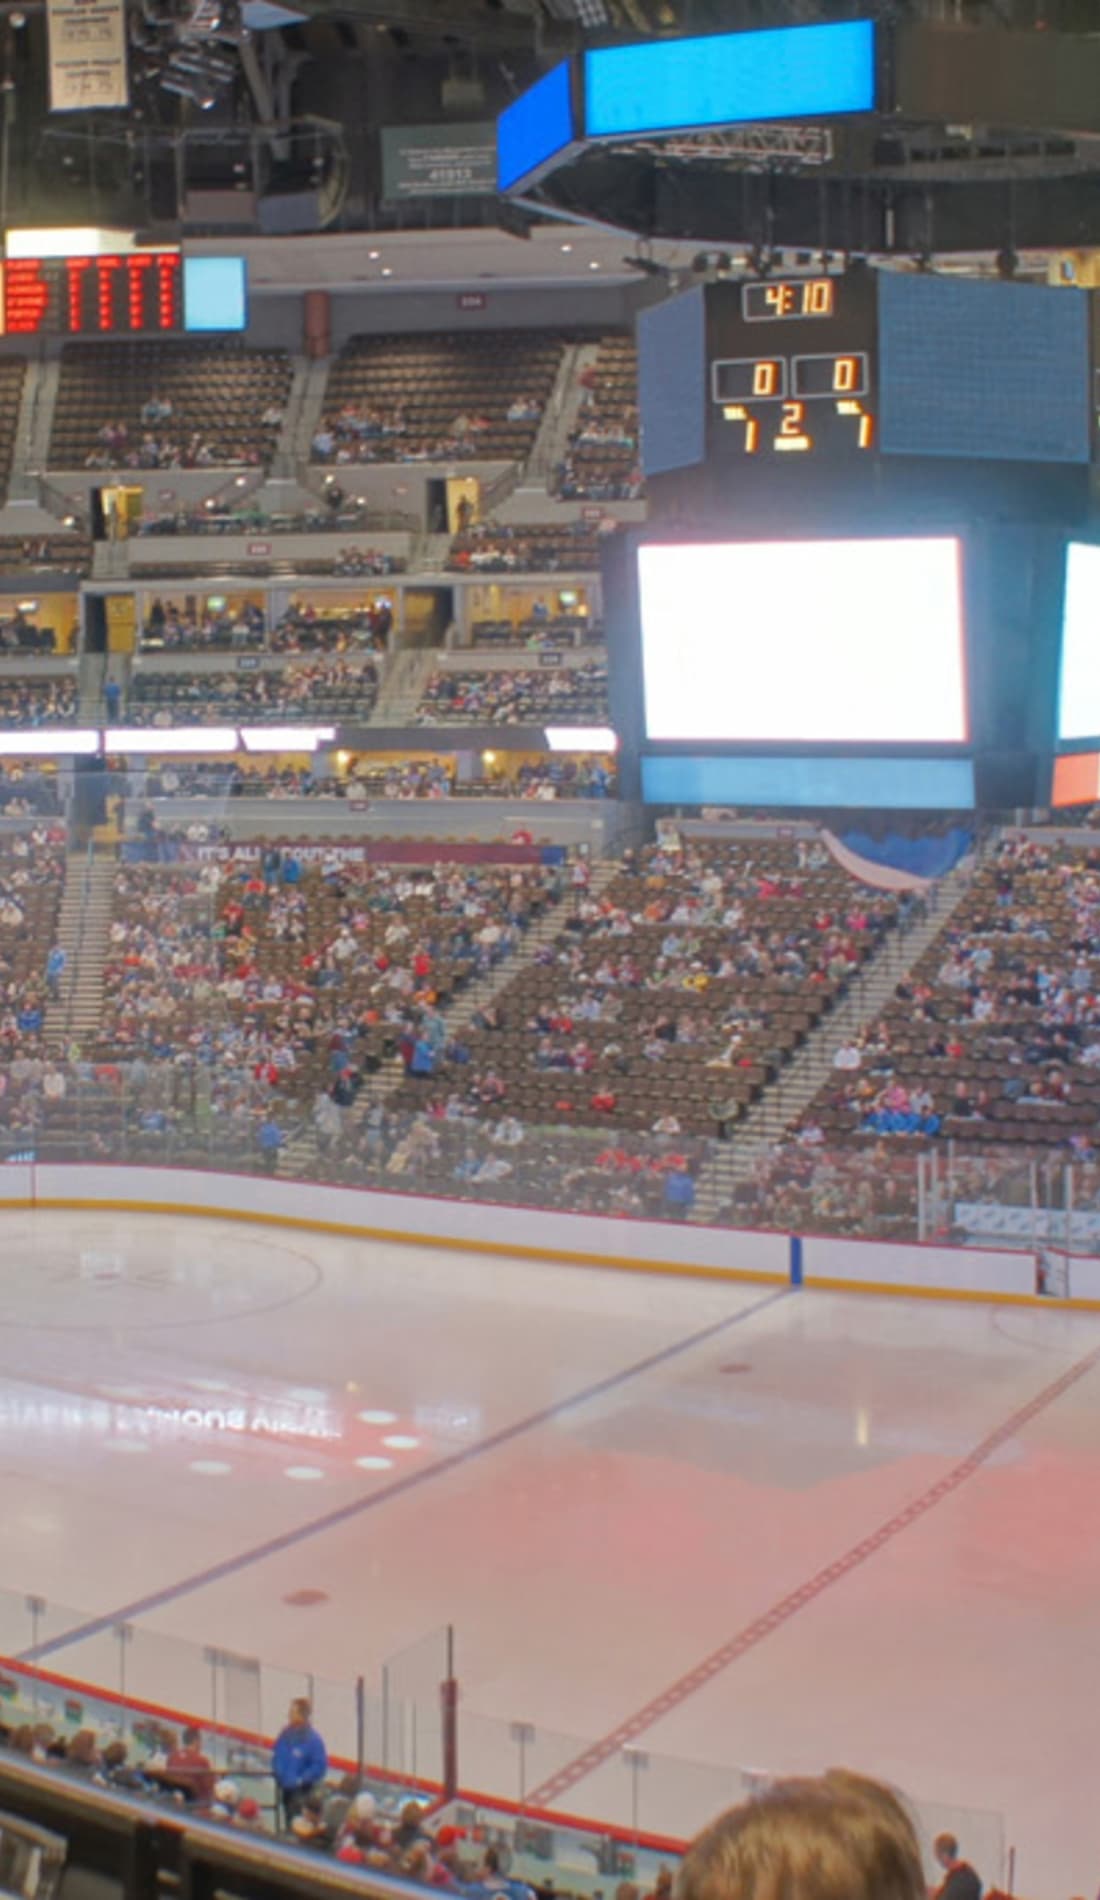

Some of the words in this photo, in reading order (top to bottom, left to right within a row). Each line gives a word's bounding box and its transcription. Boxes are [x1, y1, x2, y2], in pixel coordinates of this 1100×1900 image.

[765, 279, 832, 316] 4:10
[752, 362, 776, 396] 0
[832, 357, 856, 392] 0
[780, 401, 803, 435] 2
